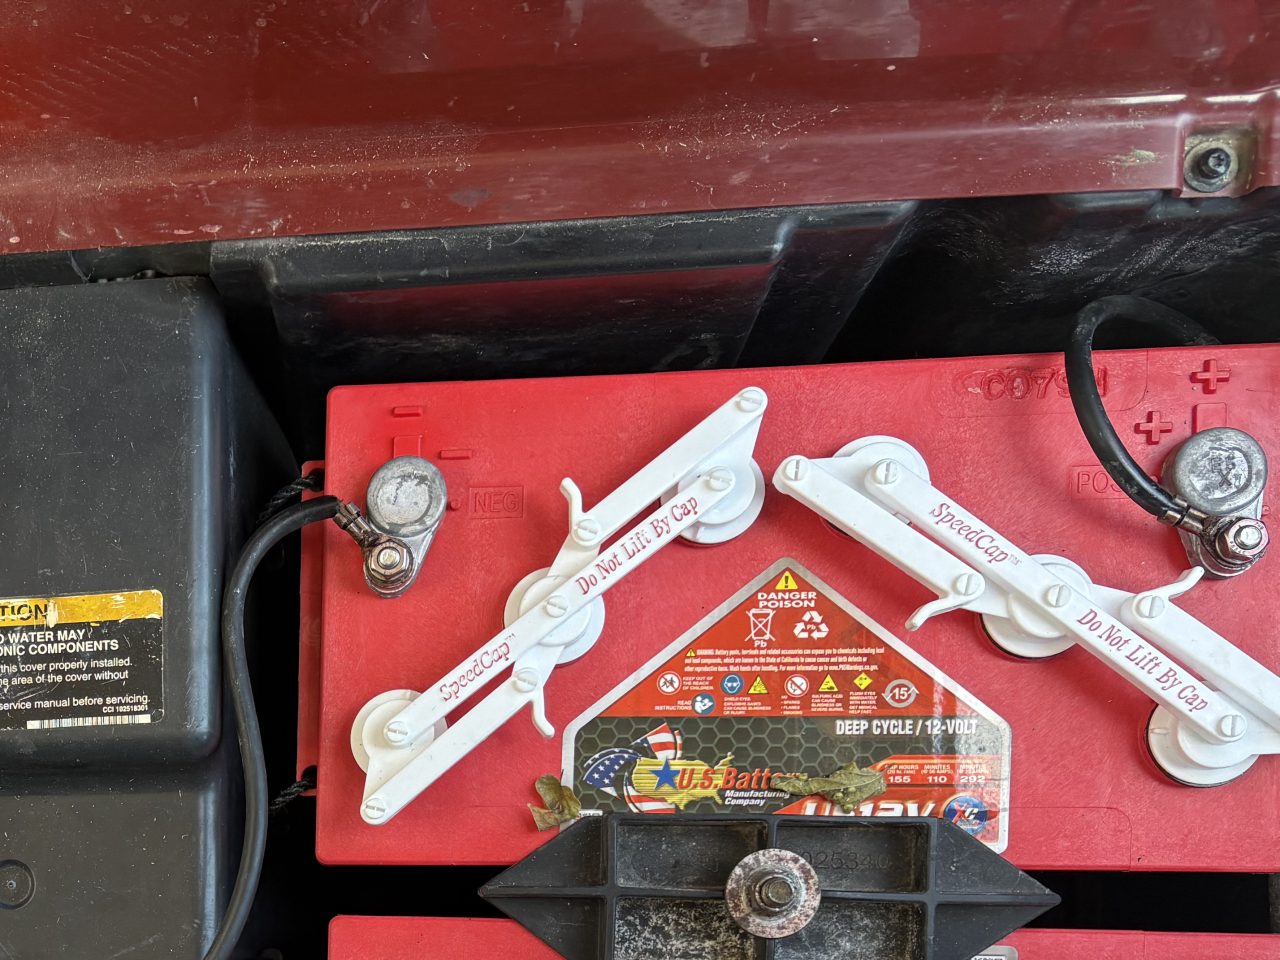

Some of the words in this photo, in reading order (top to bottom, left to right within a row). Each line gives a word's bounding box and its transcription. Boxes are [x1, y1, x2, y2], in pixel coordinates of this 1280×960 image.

[575, 573, 598, 597] Do
[596, 553, 623, 579] Not
[625, 528, 651, 557] Lift
[650, 514, 672, 537] By
[672, 497, 698, 524] Cap
[758, 591, 817, 600] DANGER
[759, 600, 815, 608] POISON
[9, 631, 54, 644] WATER
[58, 629, 85, 641] MAY
[29, 640, 118, 655] COMPONENTS
[1, 664, 17, 673] this
[20, 662, 46, 672] cover
[50, 659, 88, 671] properly
[91, 657, 132, 668] installed.
[1077, 609, 1101, 632] Do
[1098, 622, 1130, 652] Not
[1126, 643, 1160, 674] Lift
[1156, 666, 1180, 693] By
[1178, 684, 1209, 712] Cap
[12, 676, 33, 685] area
[36, 674, 45, 684] of
[48, 672, 63, 683] the
[65, 672, 91, 682] cover
[94, 670, 128, 681] without
[35, 697, 70, 708] manual
[73, 695, 103, 707] before
[106, 694, 150, 705] servicing.
[836, 719, 868, 735] DEEP
[872, 719, 914, 735] CYCLE
[925, 719, 978, 735] 12-VOLT
[725, 790, 790, 799] Manufacturing
[725, 797, 765, 807] Company
